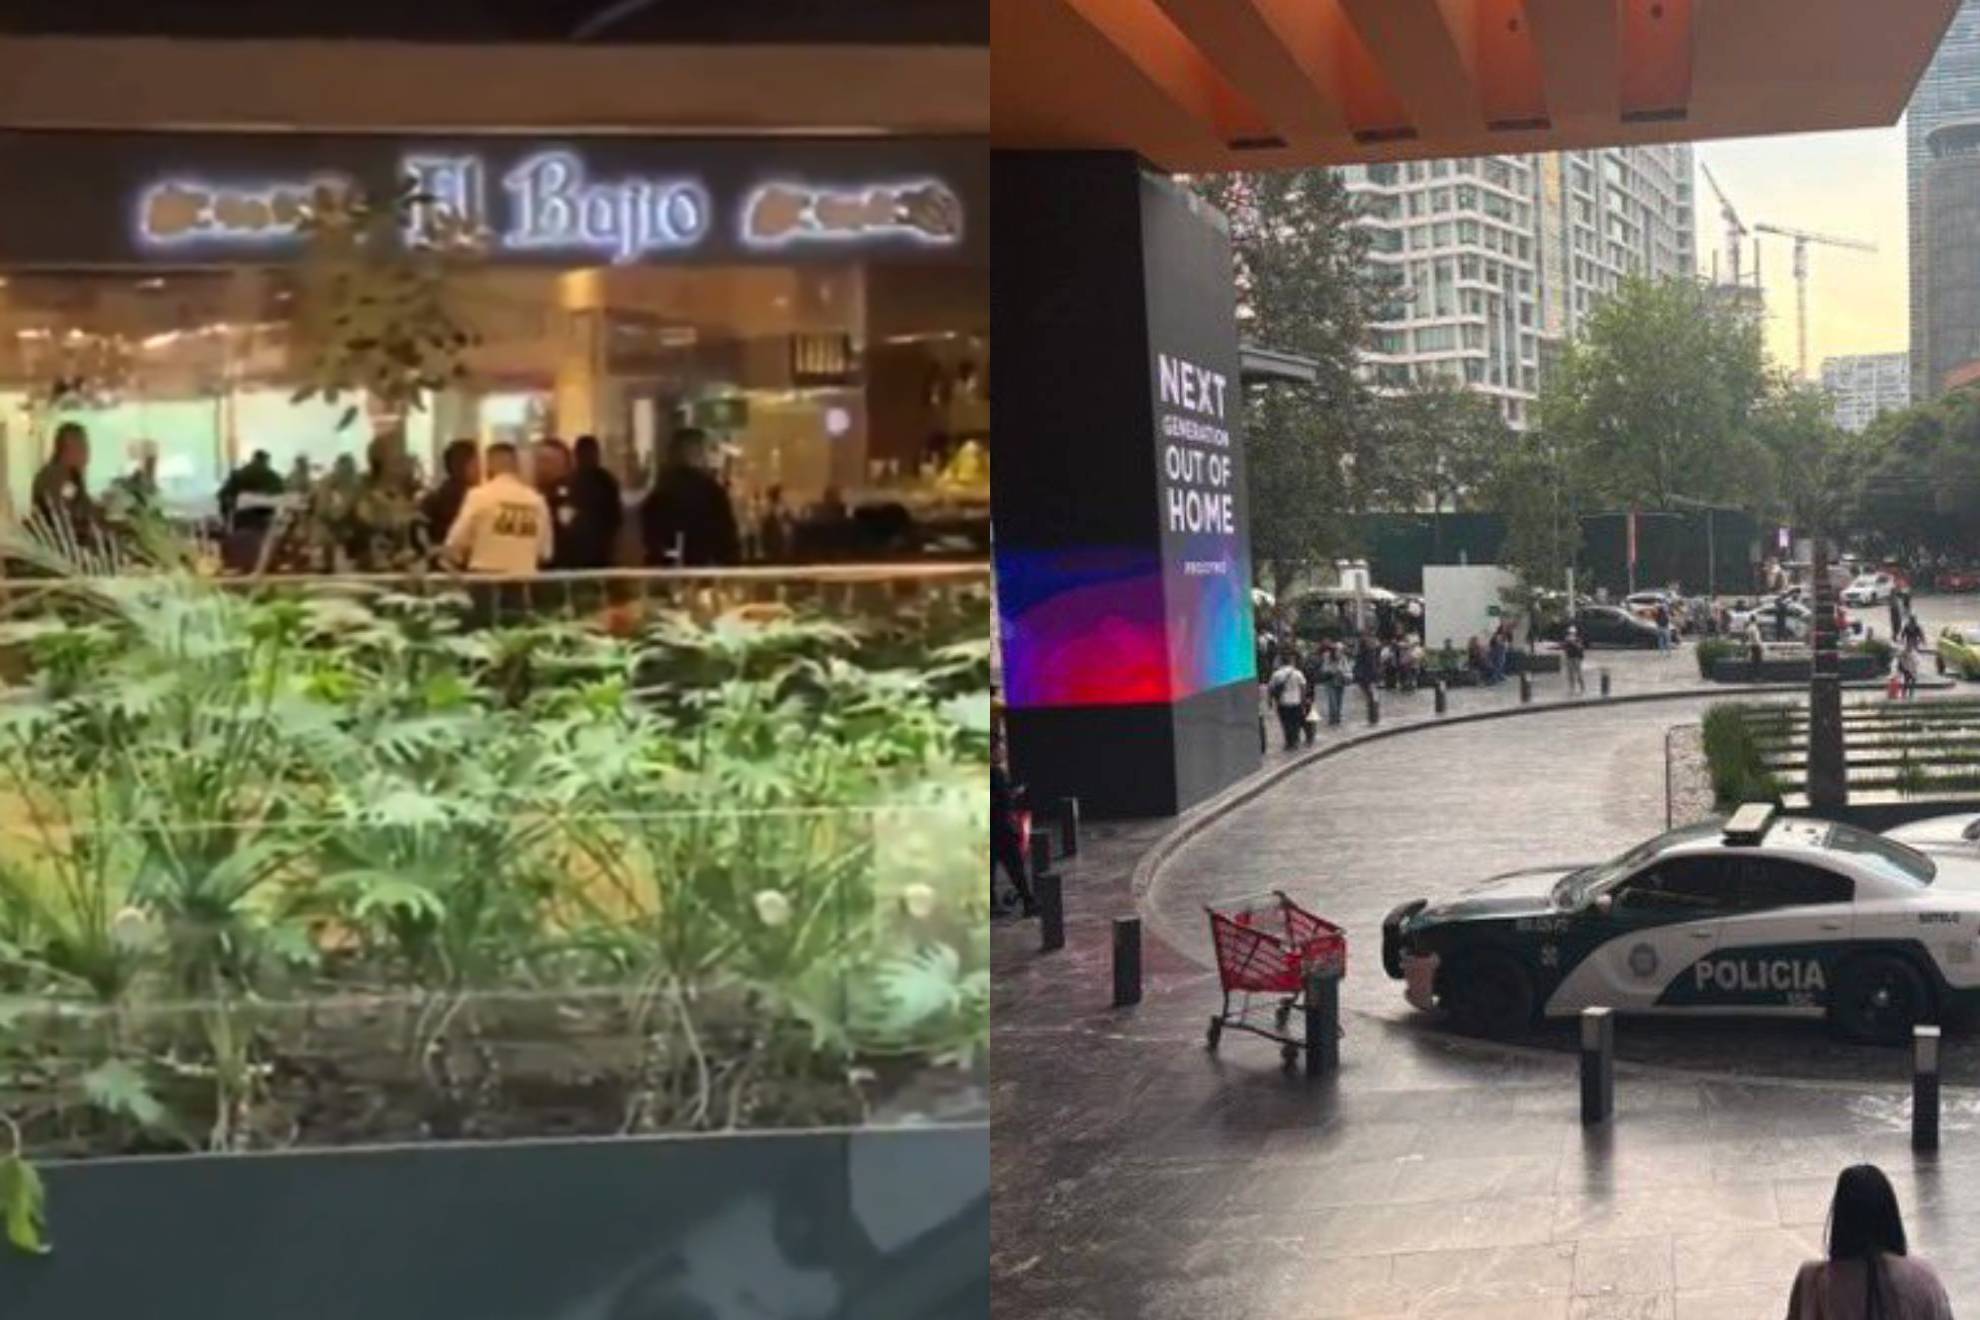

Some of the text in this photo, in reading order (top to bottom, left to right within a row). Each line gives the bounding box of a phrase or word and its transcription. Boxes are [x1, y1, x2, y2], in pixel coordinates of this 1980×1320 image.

[1158, 353, 1226, 418] NEXT
[1165, 445, 1231, 487] OUT OF
[1167, 487, 1234, 534] HOME
[1696, 960, 1826, 990] POLICIA
